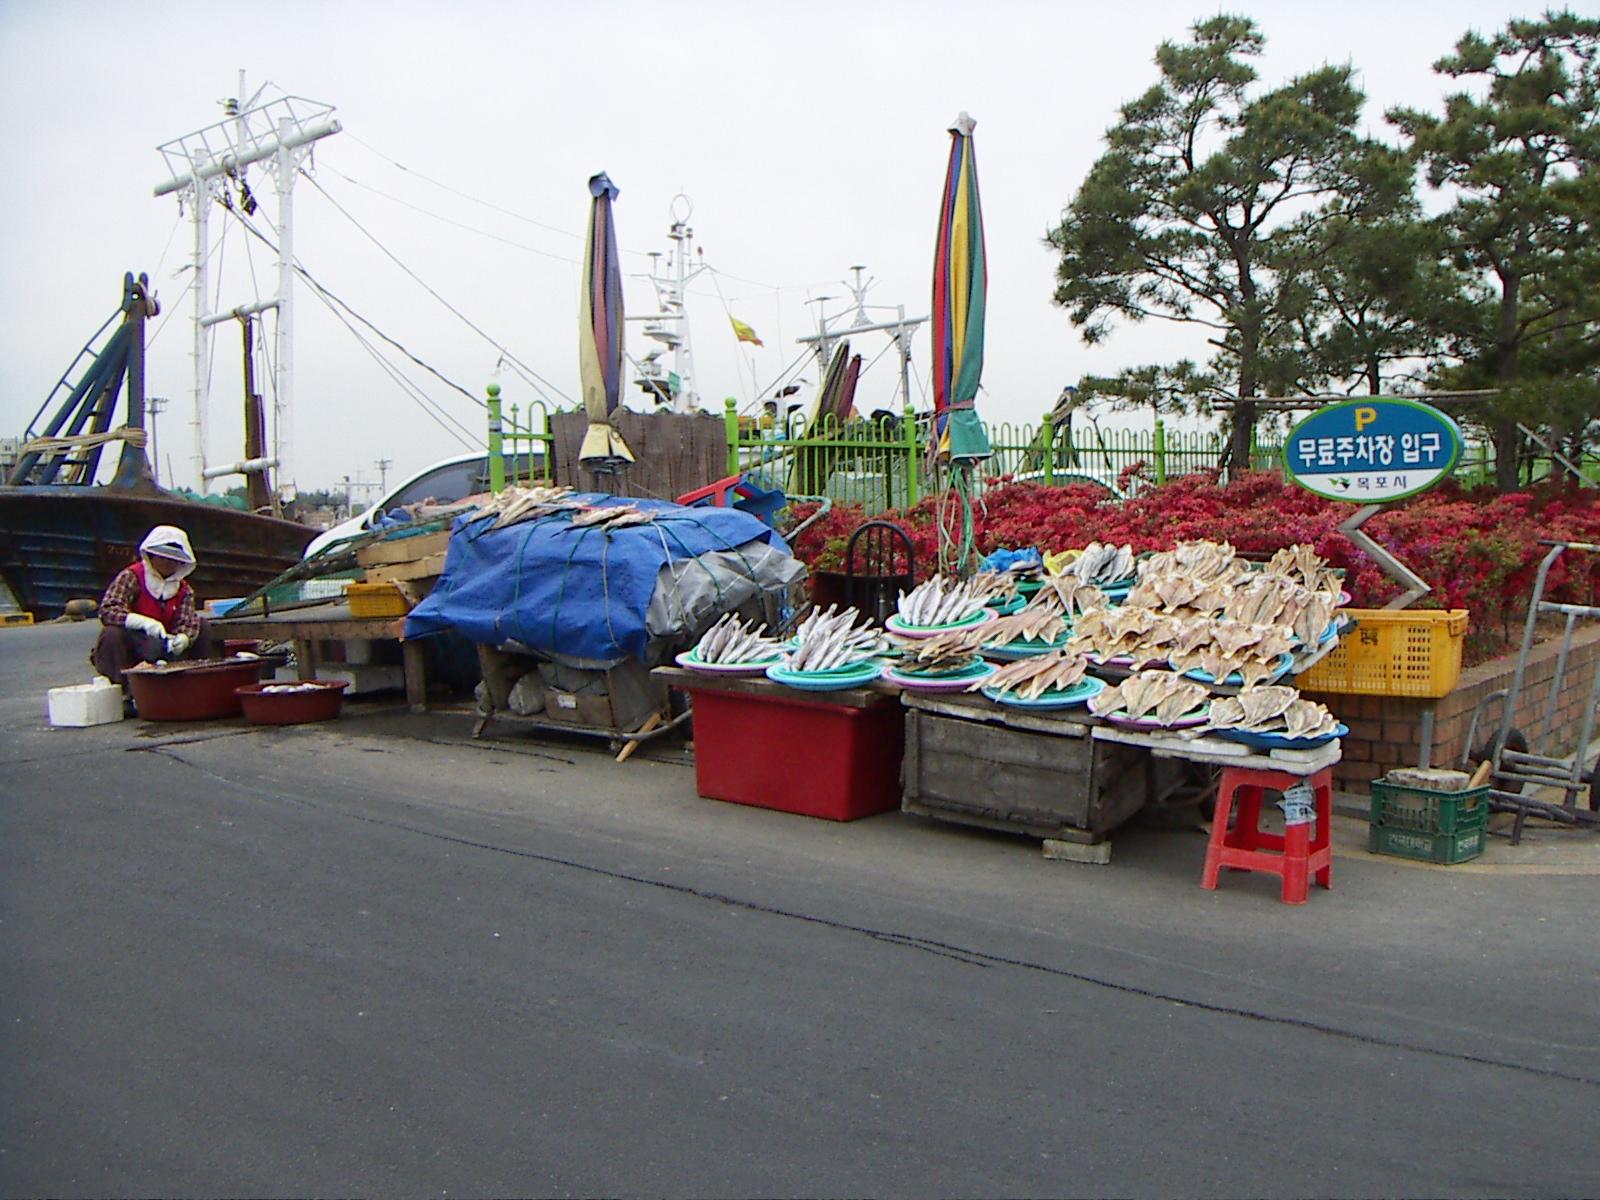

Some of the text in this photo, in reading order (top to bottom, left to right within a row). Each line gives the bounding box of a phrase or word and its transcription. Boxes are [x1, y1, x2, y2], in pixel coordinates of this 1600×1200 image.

[1354, 407, 1377, 431] P
[1299, 432, 1440, 468] 무료주차장 입구
